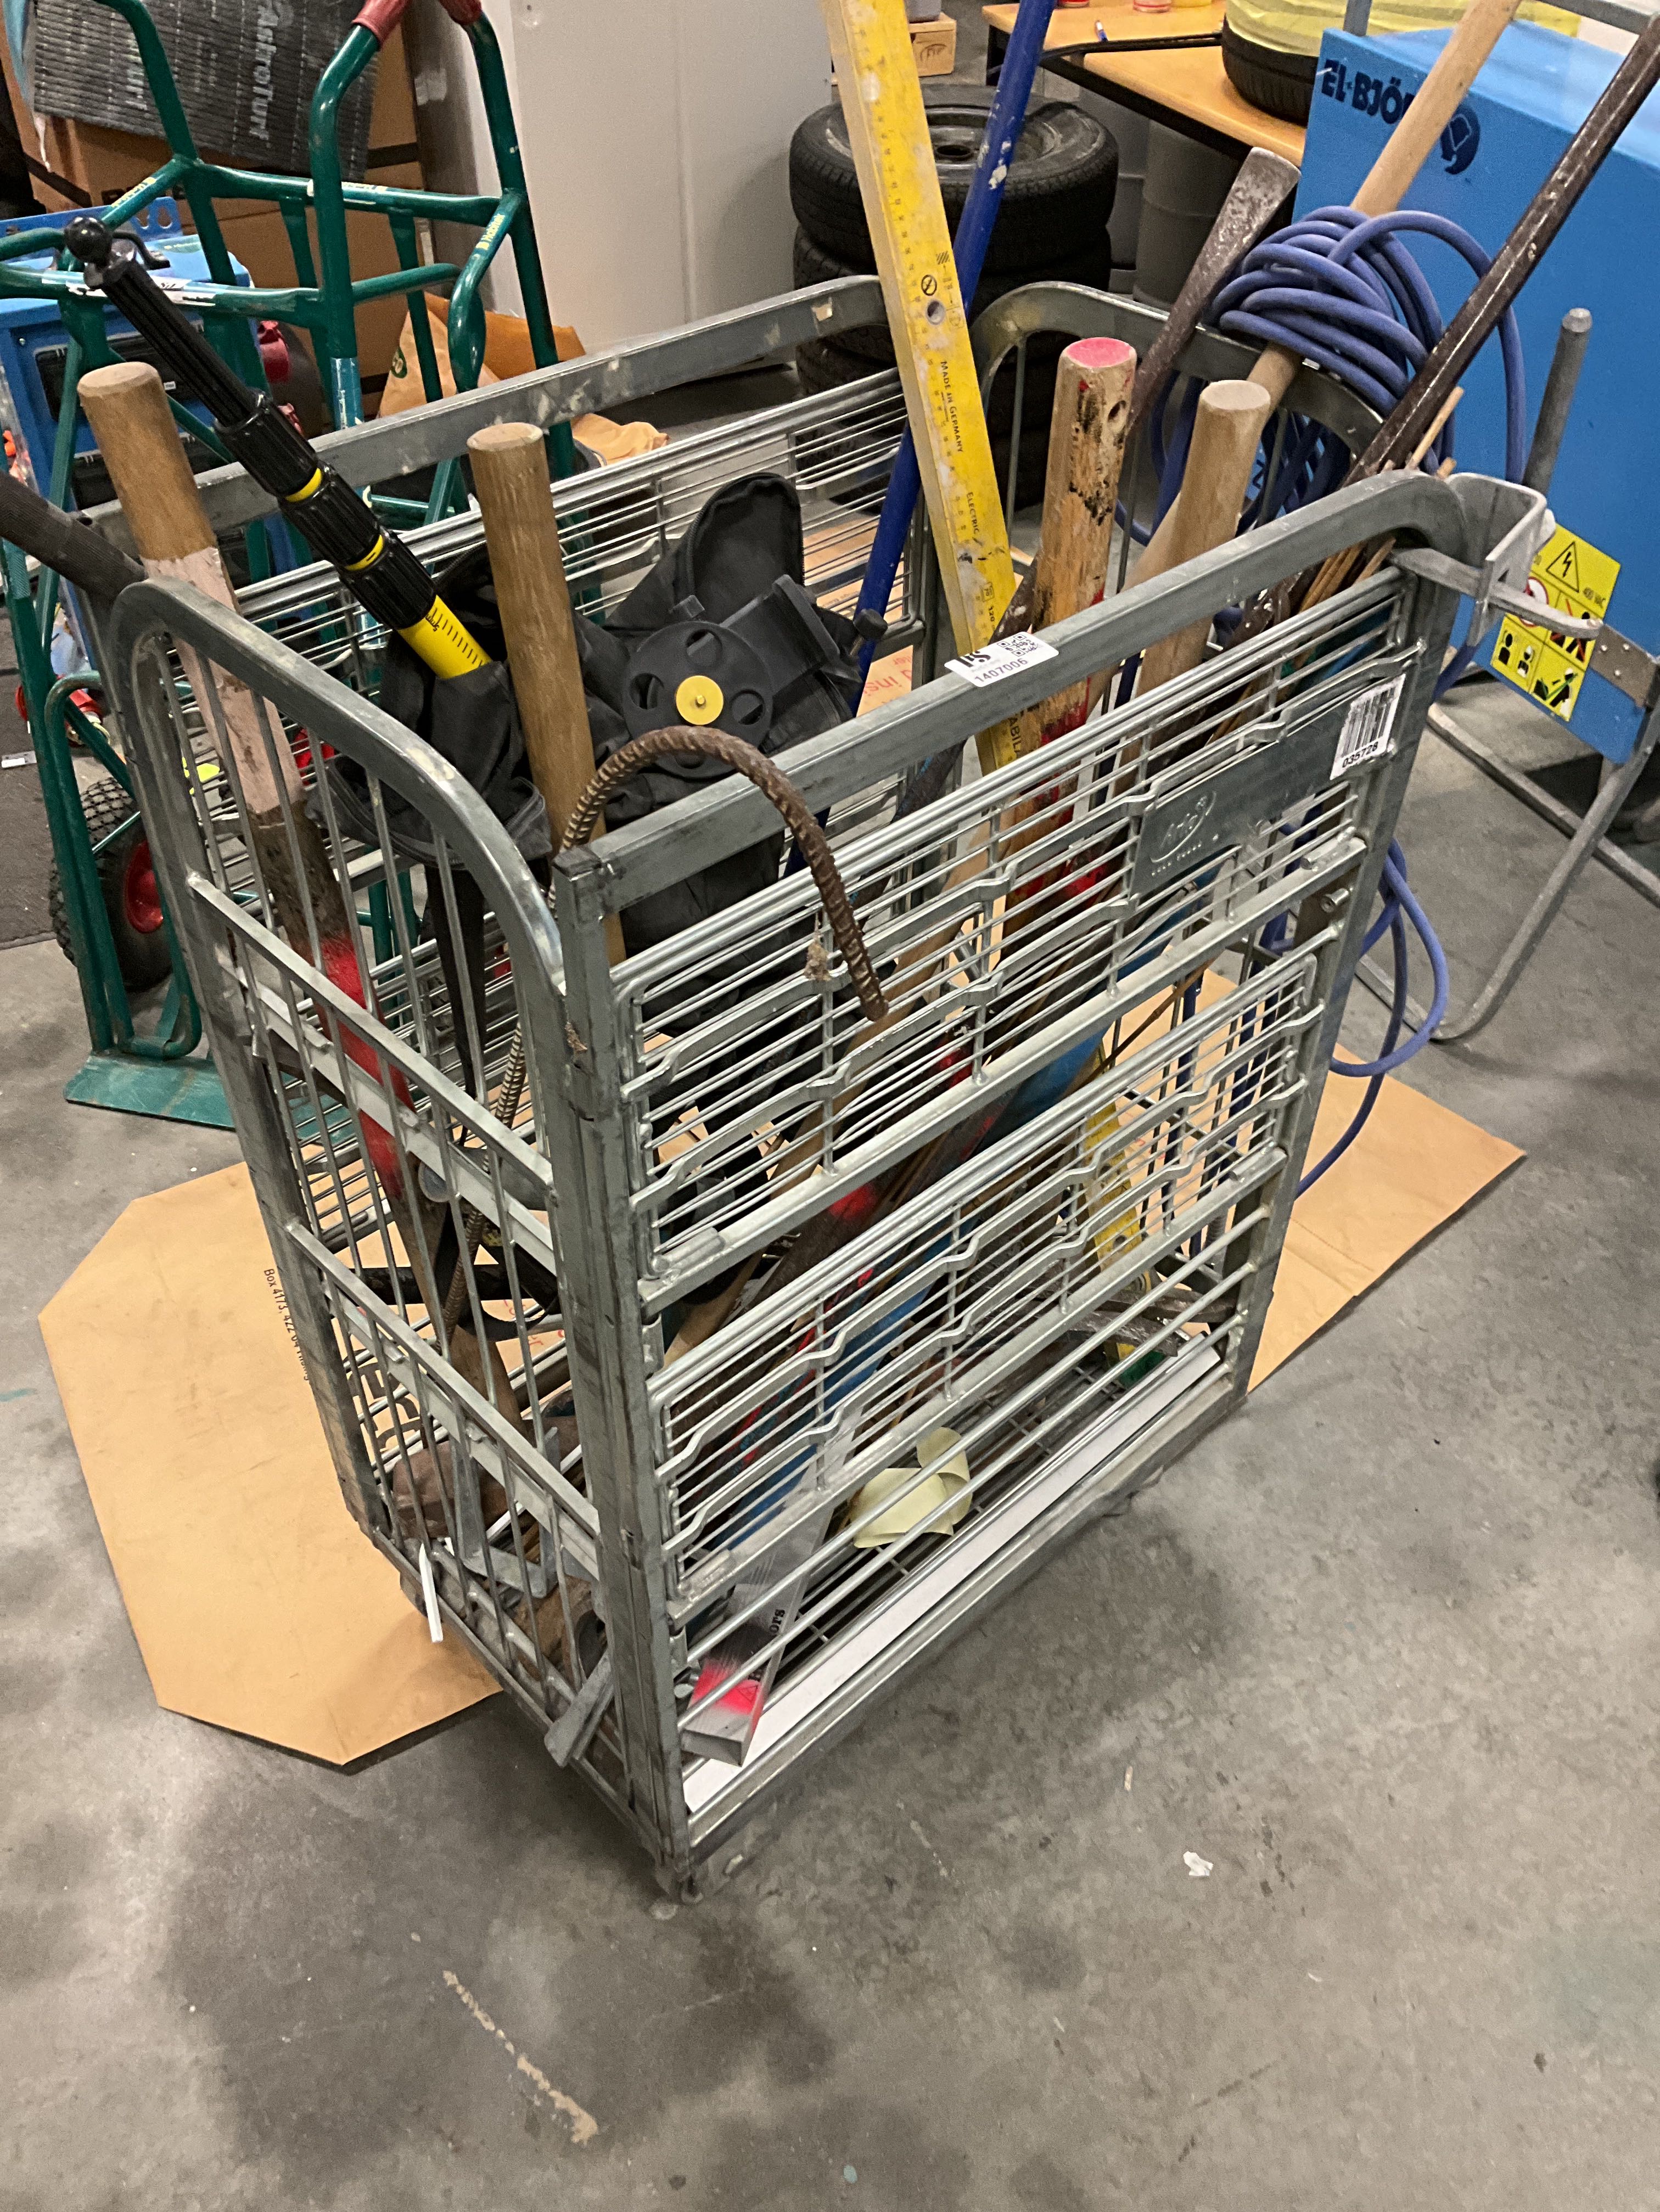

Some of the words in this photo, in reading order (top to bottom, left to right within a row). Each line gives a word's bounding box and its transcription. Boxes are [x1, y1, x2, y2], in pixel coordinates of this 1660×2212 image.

[940, 361, 952, 390] MADE
[949, 406, 963, 452] GERMANY
[966, 492, 980, 535] ELECTRIC
[974, 658, 1029, 683] 1407006
[1342, 741, 1379, 768] 035728
[263, 1268, 277, 1288] Box
